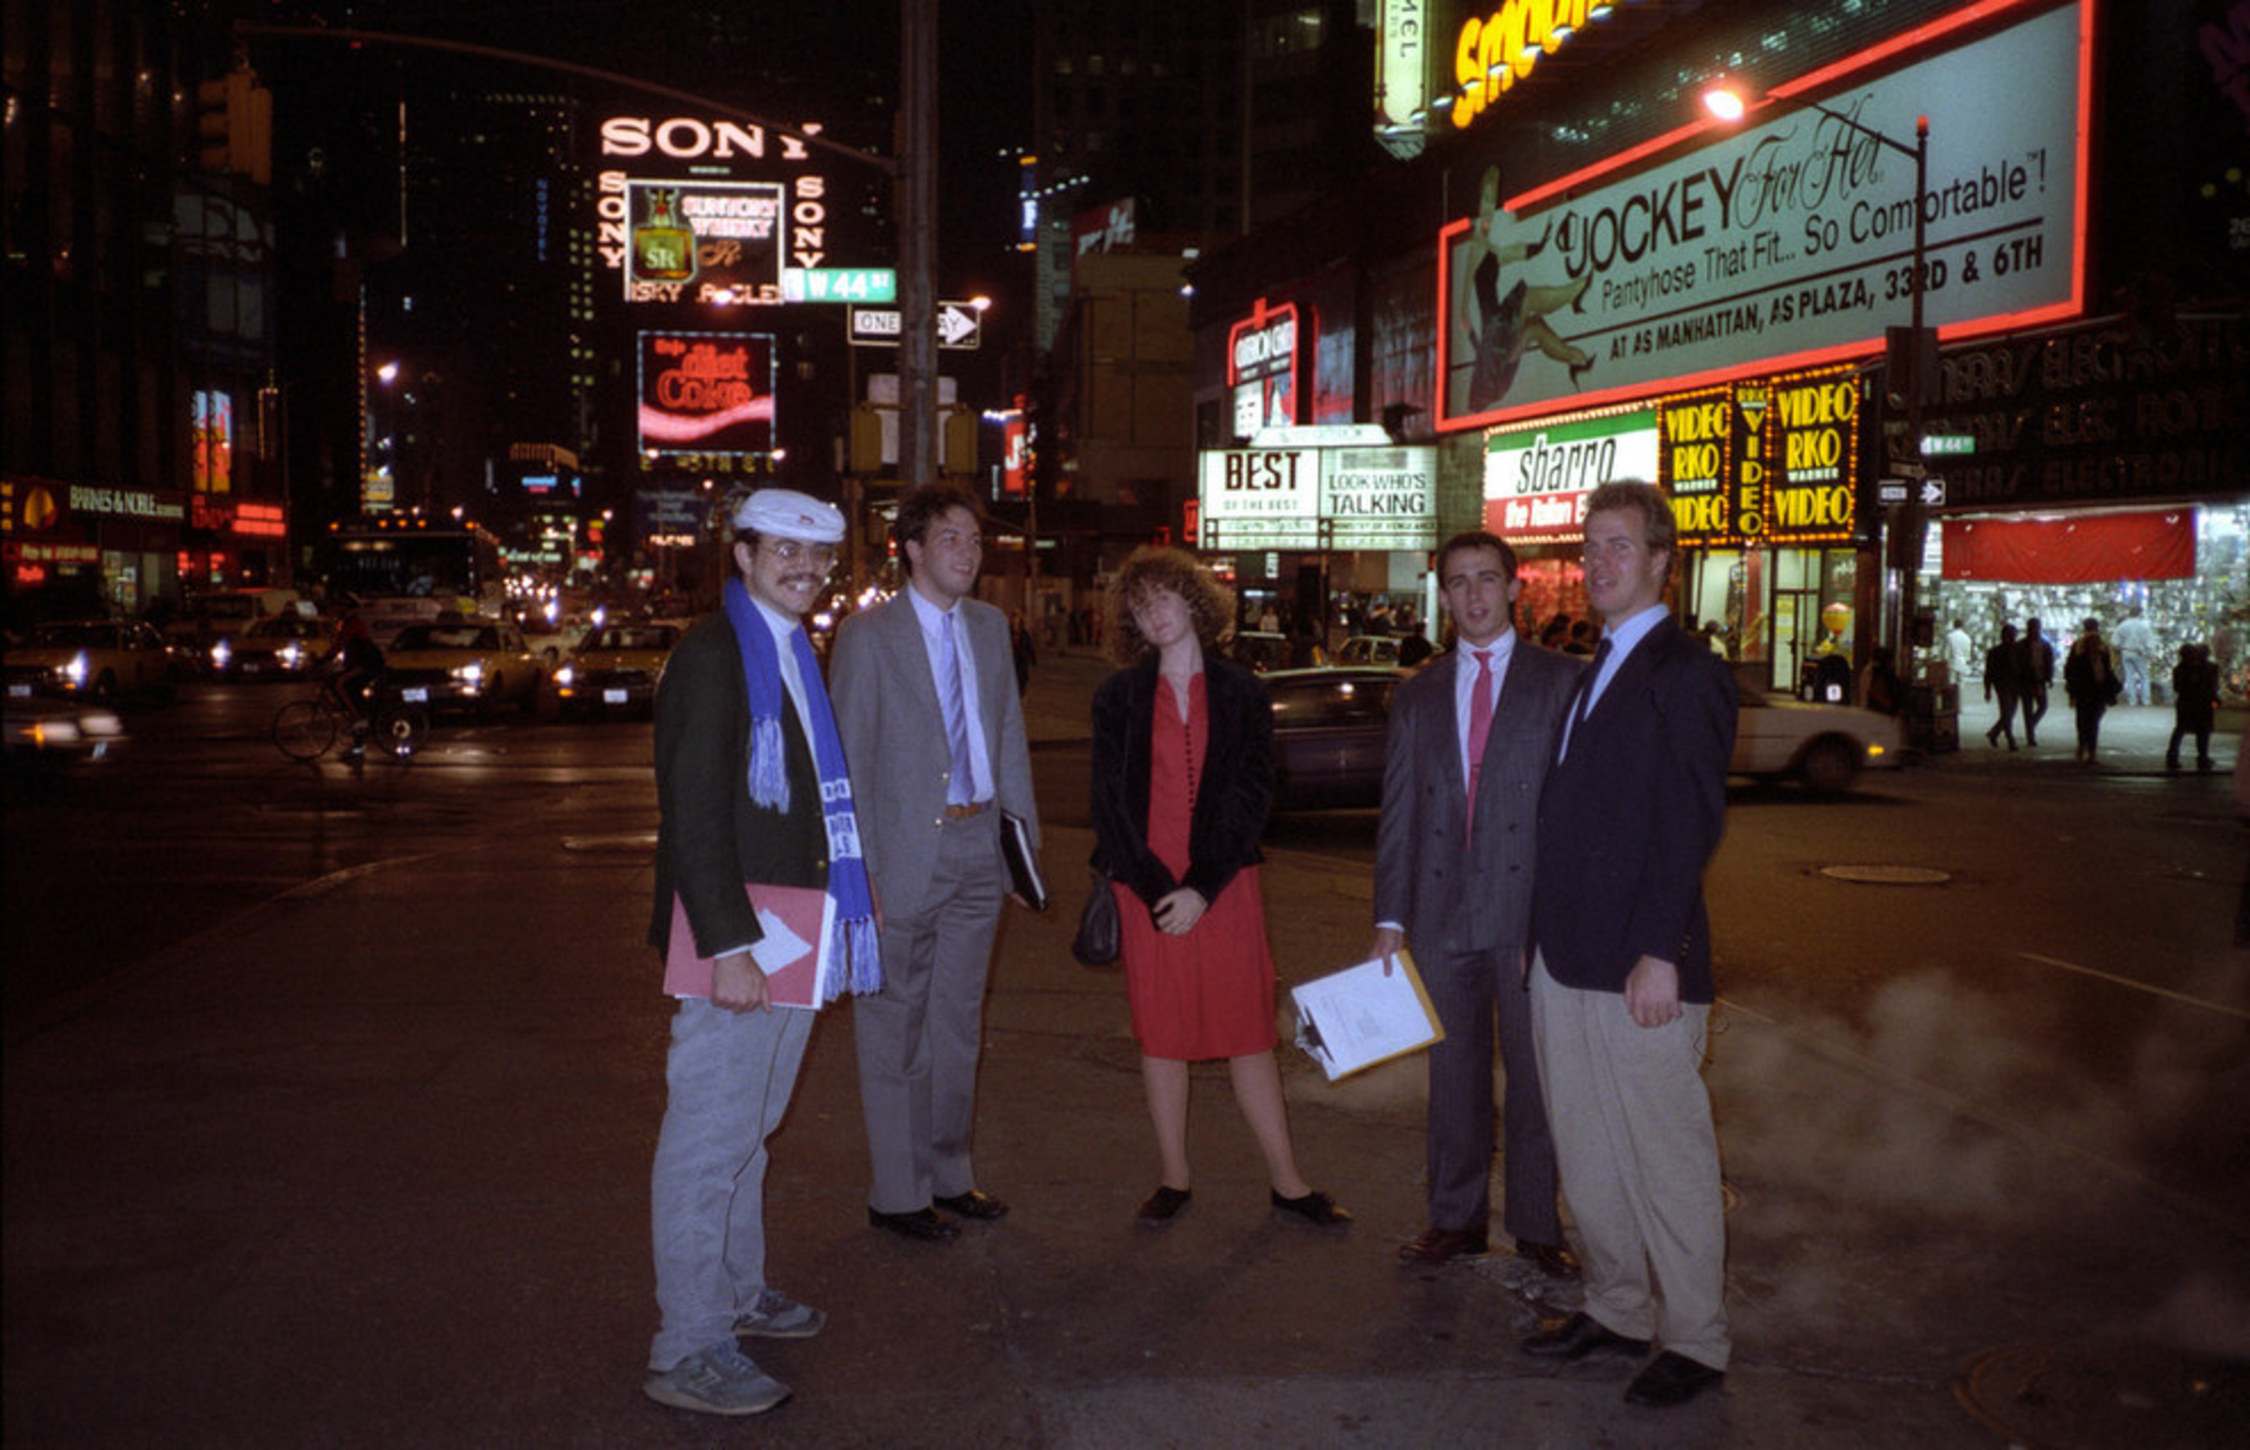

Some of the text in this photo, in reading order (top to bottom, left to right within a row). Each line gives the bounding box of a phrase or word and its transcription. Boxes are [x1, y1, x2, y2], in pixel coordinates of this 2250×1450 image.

[602, 118, 823, 159] SONY
[1565, 93, 1881, 279] JOCKEY For Her
[598, 172, 627, 269] SONY
[793, 178, 825, 269] SONY
[1602, 261, 1697, 312] Pantyhose
[1703, 240, 1747, 282] That
[1753, 228, 1797, 270] Fit...
[1804, 214, 1839, 256] So
[809, 273, 890, 299] W 44 ST
[1609, 335, 1628, 361] AT
[1633, 330, 1652, 356] AS
[1656, 303, 1764, 351] MANHATTAN,
[1769, 295, 1795, 326] AS
[1799, 277, 1875, 319] PLAZA,
[1962, 250, 1980, 284] &
[1993, 234, 2043, 277] 6TH
[861, 313, 898, 330] ONE
[657, 369, 753, 409] Coke
[1777, 382, 1855, 429] VIDEO
[1666, 402, 1730, 443] VIDEO
[1673, 443, 1719, 481] RKO
[1786, 428, 1841, 470] RKO
[1945, 439, 1961, 451] 44
[1226, 452, 1301, 490] BEST
[1329, 472, 1426, 490] LOOK WHO'S
[1517, 438, 1616, 494] sbarro
[1738, 410, 1765, 535] VIDEO
[1788, 467, 1839, 483] WARNER
[1268, 500, 1299, 511] BEST
[1329, 493, 1426, 515] TALKING
[1504, 500, 1528, 528] the
[1774, 486, 1851, 527] VIDEO
